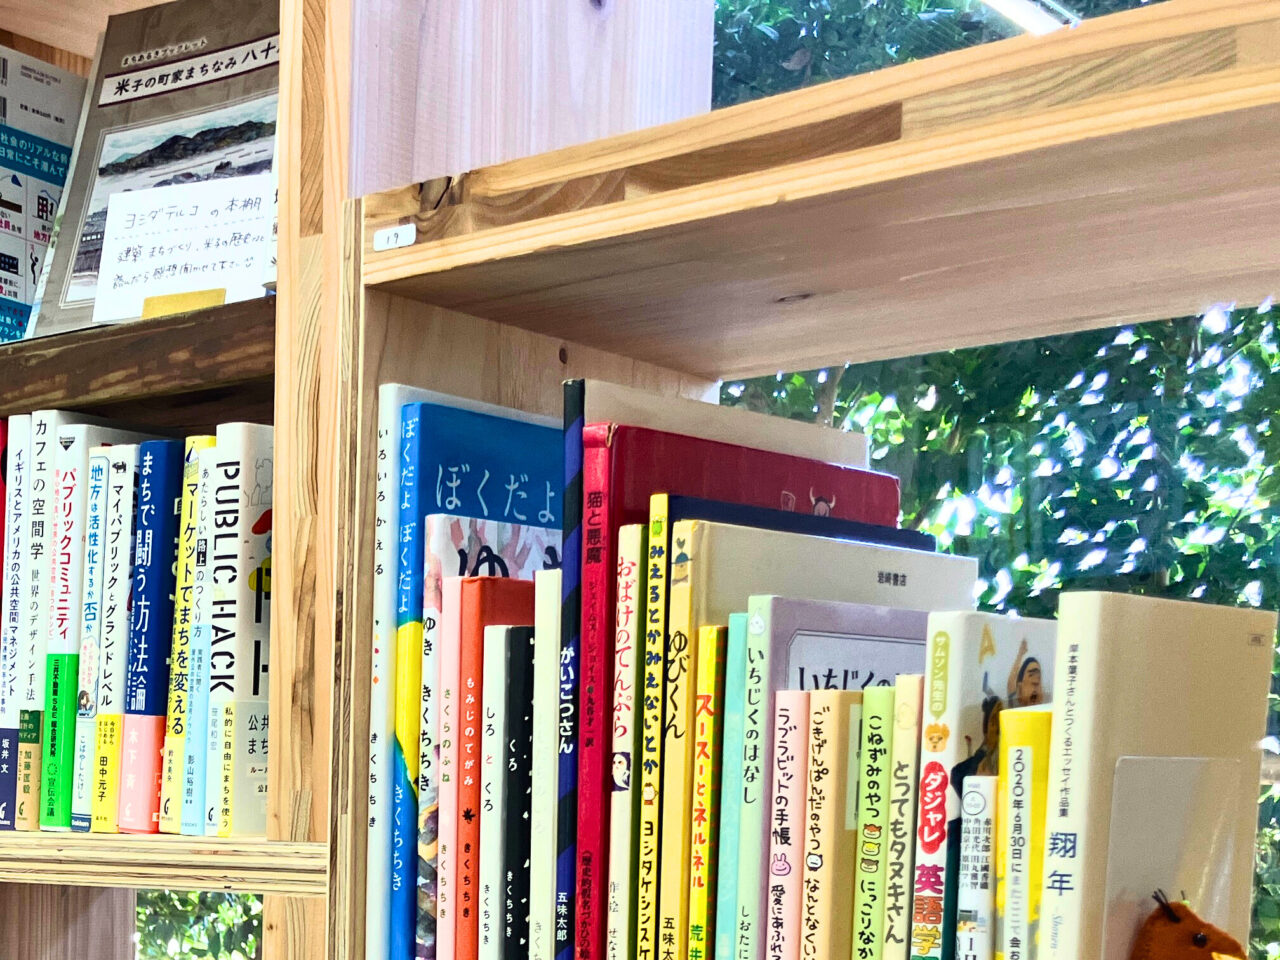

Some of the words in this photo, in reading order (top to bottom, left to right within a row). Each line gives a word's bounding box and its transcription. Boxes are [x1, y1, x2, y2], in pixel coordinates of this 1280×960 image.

[113, 56, 238, 97] 米子の町家まちなみ
[31, 419, 48, 561] カフェの空間学
[375, 428, 389, 576] いろいろかえる
[400, 417, 419, 510] ぼくだよ
[435, 463, 556, 524] ぼくだよ
[56, 467, 77, 640] パブリックコミュニティ
[81, 464, 104, 633] 地方は活性化するか否か
[193, 467, 211, 638] あたらしい路上のつくり方
[212, 460, 241, 586] PUBLIC
[398, 521, 417, 614] ぼくだよ
[586, 490, 605, 566] 猫と悪魔
[101, 484, 124, 707] マイパブリックとグランドレベル
[130, 451, 156, 711] まちで闘う方法論
[171, 482, 199, 735] マーケットでまちを変える
[877, 570, 908, 587] 岩崎書店
[26, 568, 41, 701] 世界のデザイン手法
[210, 600, 237, 693] HACK
[422, 616, 436, 656] ゆき
[613, 557, 638, 739] おばけのてんぷら
[642, 545, 666, 775] みえるとかみえないとか
[664, 630, 691, 739] ゆびくん
[419, 684, 433, 792] きくちちき
[441, 688, 451, 783] さくらのふね
[463, 677, 476, 786] もみじのてがみ
[558, 646, 576, 754] がいこつさん
[743, 647, 765, 805] いちじくのはなし
[97, 756, 108, 802] 田中元子
[221, 706, 233, 828] 私的に自由にまちを使う
[368, 732, 379, 828] きくちちき
[483, 782, 494, 812] くろ
[508, 739, 519, 772] くろ
[692, 693, 715, 889] スースーとネルネル
[771, 707, 798, 847] ラブラビットの手帳
[808, 705, 831, 851] ごきげんぱんだのやつ
[863, 715, 887, 818] こねずみのやつ
[922, 770, 947, 843] ダジャレ
[392, 784, 406, 891] きくちちき
[439, 845, 448, 919] きくちちき
[462, 841, 472, 919] きくちちき
[638, 820, 654, 960] ヨシタケシンスケ
[884, 760, 912, 945] とってもタヌキさん
[1047, 831, 1078, 896] 翔年
[505, 871, 514, 938] きくちちき
[556, 892, 569, 942] 五味太郎
